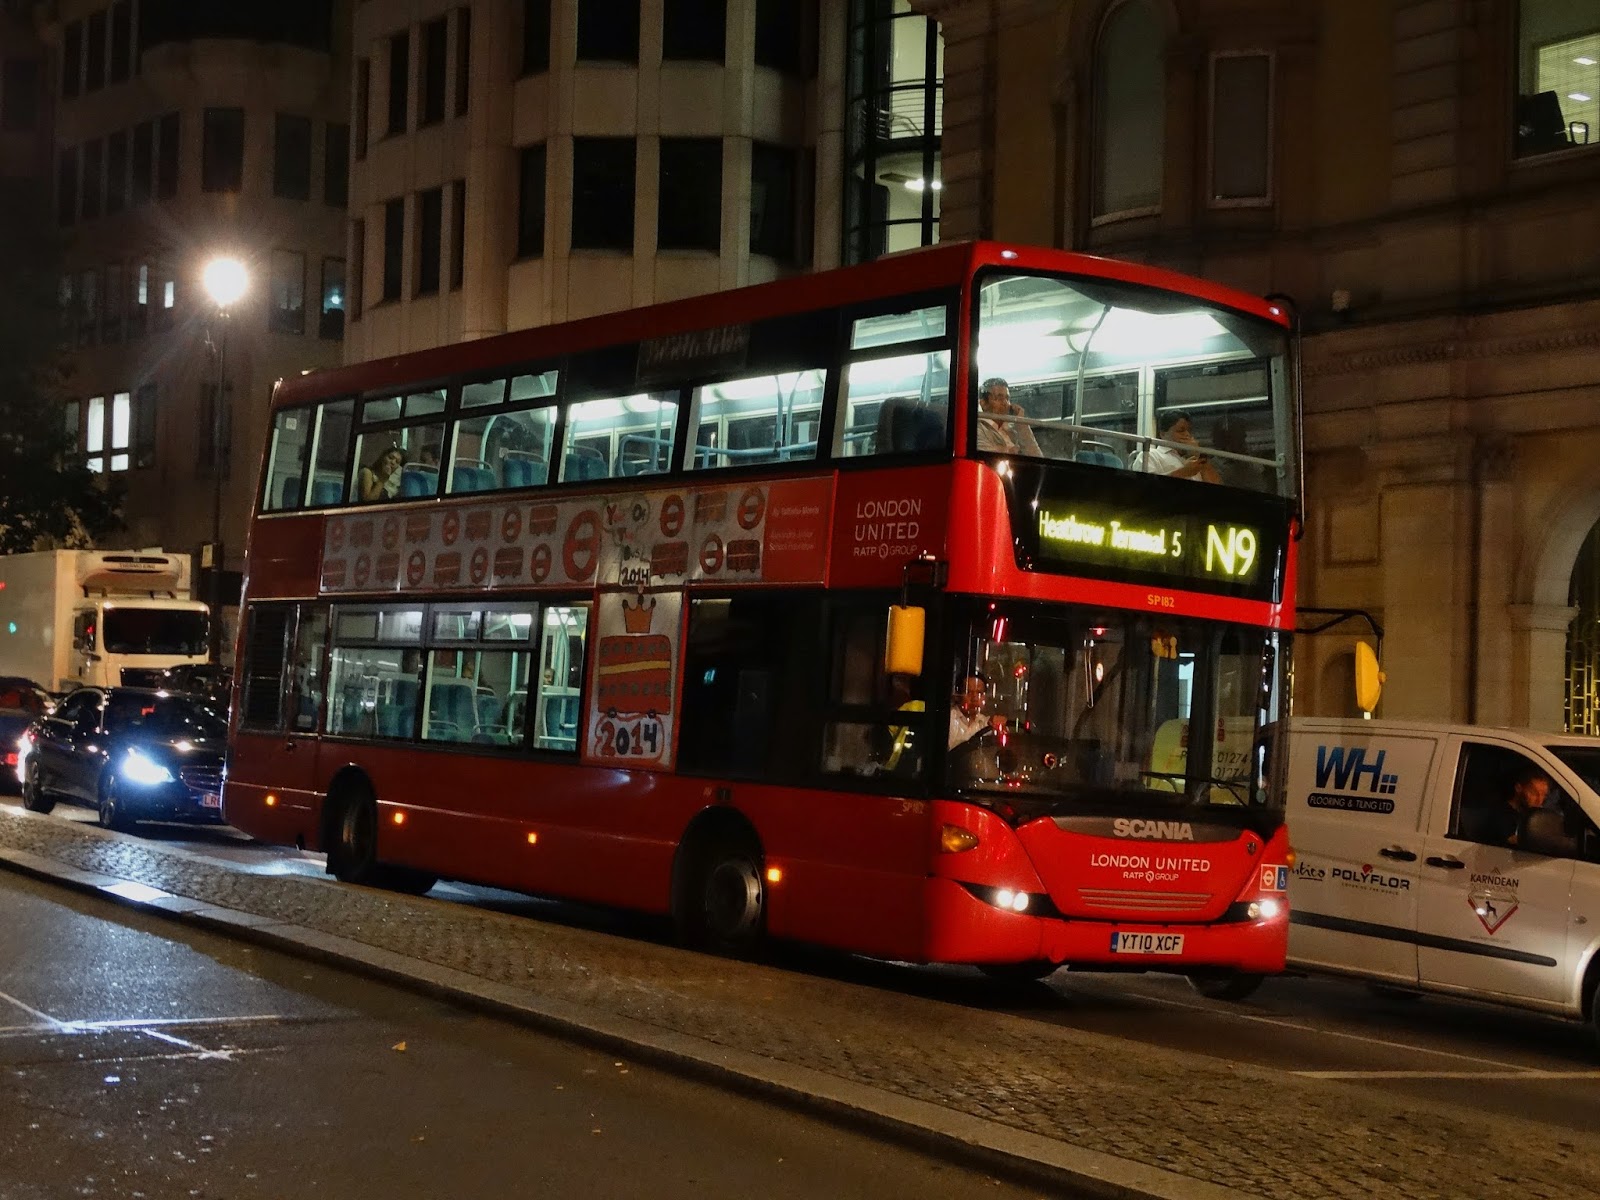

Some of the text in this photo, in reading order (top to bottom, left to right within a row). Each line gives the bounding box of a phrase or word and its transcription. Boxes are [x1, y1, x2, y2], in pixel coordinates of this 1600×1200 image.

[856, 499, 922, 518] LONDON
[855, 522, 919, 541] UNITED
[854, 545, 917, 556] RATP GROUP
[1171, 531, 1182, 557] 5
[1206, 525, 1256, 576] N9
[621, 567, 650, 586] 2014
[601, 721, 657, 757] 2014
[1316, 746, 1386, 792] WH
[1309, 796, 1393, 812] FLOORING & TILING LTD
[1113, 818, 1194, 840] SCANIA
[1091, 854, 1211, 872] LONDON UNITED
[1122, 871, 1180, 881] RATP GROUP
[1332, 867, 1411, 890] POLYFLOR
[1470, 873, 1519, 888] KARNDEAN
[1122, 935, 1181, 950] YT10 XCF
